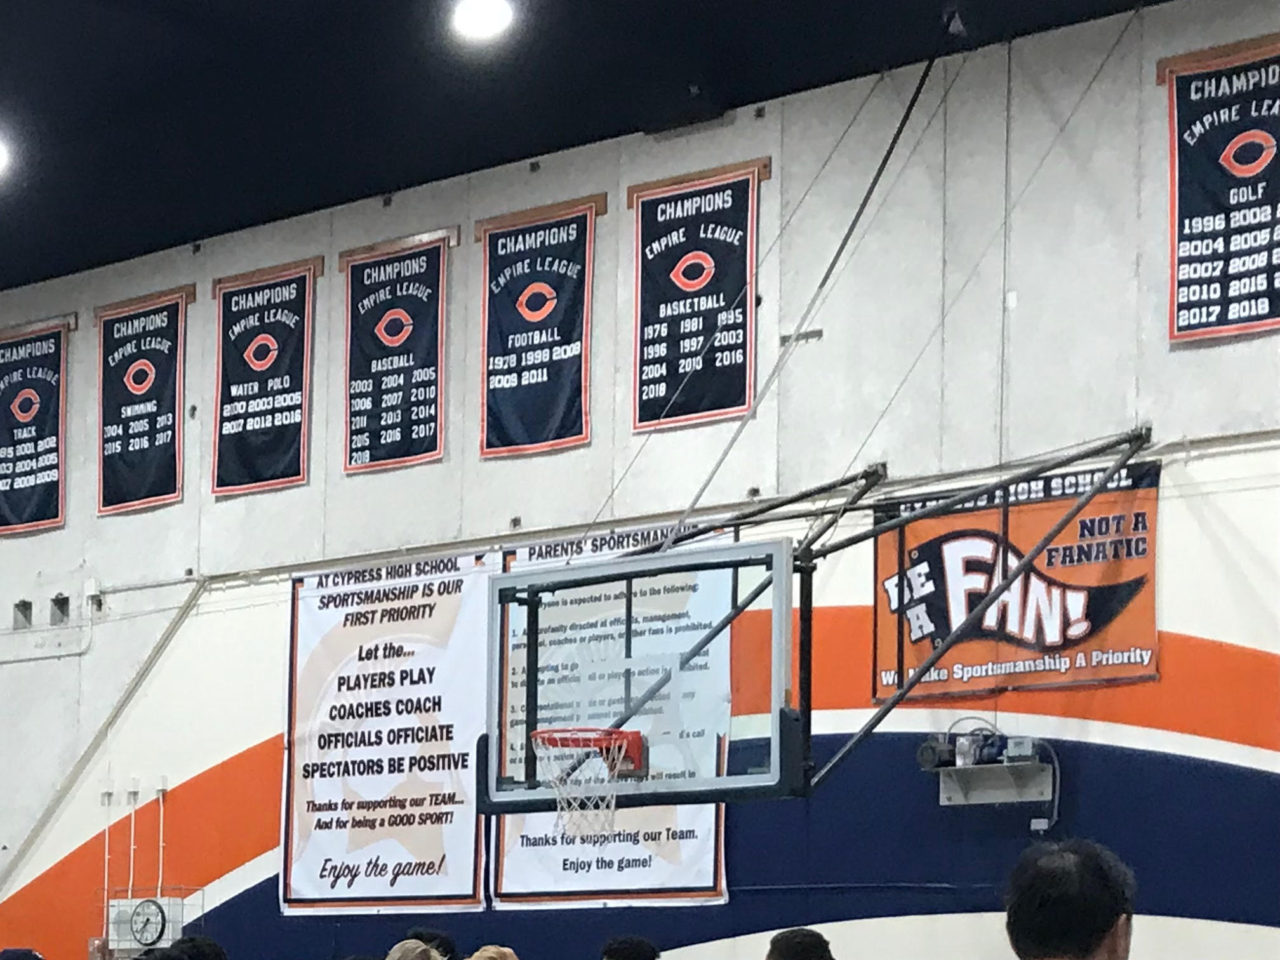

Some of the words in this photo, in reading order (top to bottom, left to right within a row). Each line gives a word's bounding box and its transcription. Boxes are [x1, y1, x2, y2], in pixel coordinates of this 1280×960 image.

[1183, 104, 1240, 146] EMPIRE
[657, 190, 732, 222] CHAMPIONS
[1230, 182, 1266, 204] GOLF
[1183, 213, 1225, 234] 1996
[1230, 205, 1271, 228] 2002
[498, 223, 577, 255] CHAMPIONS
[646, 228, 686, 260] EMPIRE
[700, 223, 743, 245] LEAGUE
[1179, 237, 1224, 257] 2004
[1230, 228, 1271, 251] 2005
[363, 256, 427, 285] CHAMPIONS
[491, 259, 530, 294] EMPIRE
[537, 257, 582, 279] LEAGUE
[1179, 260, 1224, 280] 2007
[1228, 251, 1268, 274] 2008
[231, 283, 297, 312] CHAMPIONS
[358, 285, 392, 315] EMPIRE
[397, 282, 432, 302] LEAGUE
[1179, 283, 1220, 303] 2010
[1229, 274, 1267, 297] 2015
[659, 293, 726, 318] BASKETBALL
[1179, 305, 1221, 326] 2017
[1228, 298, 1269, 319] 2018
[114, 311, 168, 338] CHAMPIONS
[229, 313, 260, 341] EMPIRE
[264, 308, 300, 329] LEAGUE
[508, 327, 561, 348] FOOTBALL
[644, 323, 668, 341] 1976
[681, 317, 703, 333] 1981
[108, 340, 137, 367] EMPIRE
[141, 337, 172, 354] LEAGUE
[644, 343, 667, 359] 1996
[680, 336, 704, 353] 1997
[714, 329, 743, 347] 2003
[371, 353, 415, 373] BASEBALL
[521, 349, 550, 366] 1998
[642, 363, 667, 380] 2004
[715, 349, 743, 367] 2016
[27, 367, 59, 386] LEAGUE
[230, 381, 259, 397] WATER
[268, 375, 290, 391] POLO
[381, 373, 404, 389] 2004
[412, 367, 436, 383] 2005
[521, 368, 548, 385] 2011
[274, 392, 301, 408] 2005
[411, 386, 436, 401] 2010
[642, 383, 666, 400] 2018
[121, 400, 157, 418] SWIMMING
[411, 404, 435, 420] 2014
[13, 426, 37, 440] TRACK
[412, 423, 435, 439] 2017
[1078, 516, 1125, 538] NOT
[1132, 512, 1149, 532] A
[528, 539, 588, 561] PARENTS'
[1046, 537, 1147, 568] FANATIC
[317, 574, 330, 589] AT
[332, 568, 382, 587] CYPRESS
[385, 564, 412, 580] HIGH
[415, 557, 460, 576] SCHOOL
[318, 585, 418, 610] SPORTSMANSHIP
[422, 581, 434, 597] IS
[437, 579, 464, 596] OUR
[941, 537, 1090, 647] FAN!
[343, 610, 378, 628] FIRST
[380, 602, 436, 624] PRIORITY
[906, 602, 935, 641] A
[358, 645, 378, 662] Let
[383, 642, 415, 659] the...
[953, 654, 1069, 681] Sportsmanship
[1075, 653, 1086, 667] A
[1092, 647, 1151, 666] Priority
[338, 671, 395, 692] PLAYERS
[400, 667, 436, 686] PLAY
[329, 701, 391, 721] COACHES
[395, 696, 442, 715] COACH
[318, 730, 383, 750] OFFICIALS
[387, 724, 454, 745] OFFICIATE
[302, 759, 384, 779] SPECTATORS
[388, 757, 405, 774] BE
[409, 752, 469, 772] POSITIVE
[306, 800, 338, 813] Thanks
[341, 798, 355, 811] for
[356, 796, 407, 811] supporting
[409, 797, 427, 807] our
[314, 818, 332, 830] And
[335, 817, 349, 829] for
[351, 816, 376, 830] being
[379, 818, 385, 827] a
[388, 814, 415, 827] GOOD
[418, 811, 454, 825] SPORT!
[520, 834, 558, 848] Thanks
[560, 832, 576, 846] for
[580, 830, 640, 845] supporting
[643, 830, 661, 841] our
[666, 827, 698, 841] Team.
[319, 858, 360, 889] Enjoy
[365, 855, 388, 877] the
[390, 853, 446, 887] game!
[562, 856, 592, 873] Enjoy
[596, 857, 614, 870] the
[617, 855, 652, 872] game!
